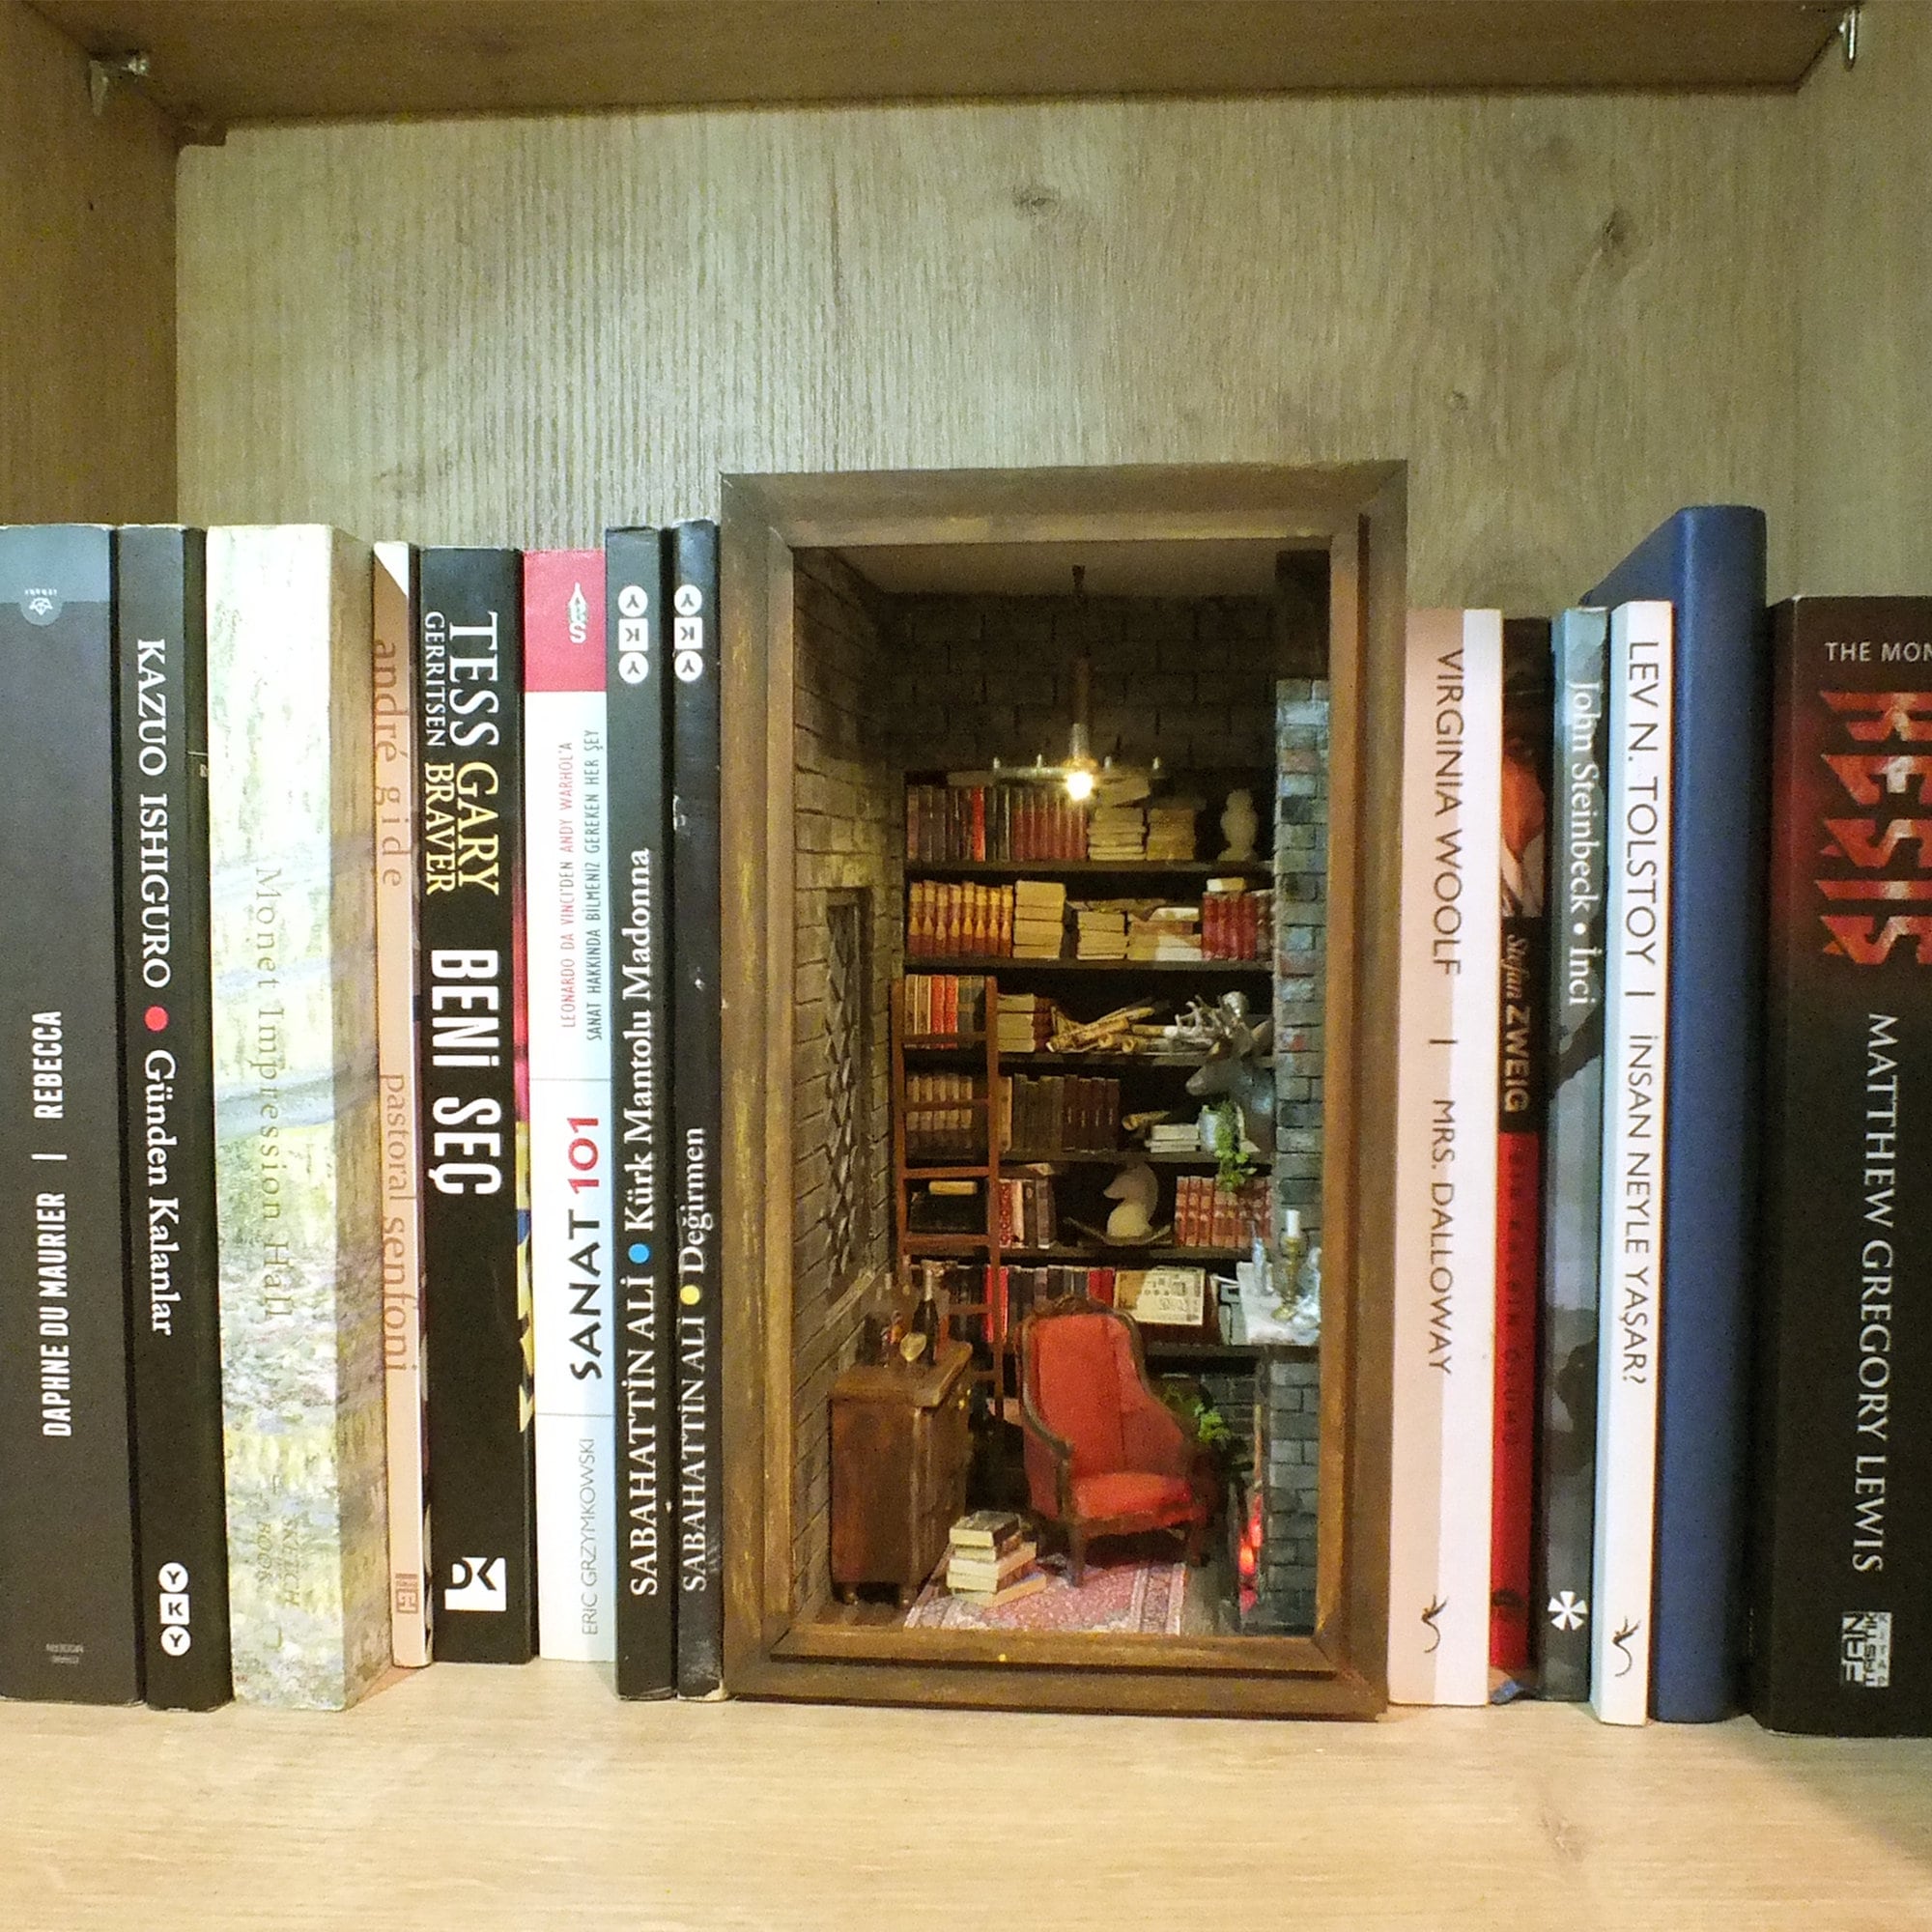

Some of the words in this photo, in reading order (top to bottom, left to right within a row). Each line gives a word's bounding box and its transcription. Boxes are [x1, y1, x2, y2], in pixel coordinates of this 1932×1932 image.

[373, 639, 409, 762] andré
[424, 611, 446, 748] GERRITSEN
[449, 611, 500, 748] TESS
[1627, 641, 1660, 708] LEV
[1824, 640, 1872, 663] THE
[137, 639, 168, 777] KAZUO
[582, 728, 605, 753] ŞEY
[1435, 648, 1464, 817] VIRGINIA
[1569, 681, 1603, 753] John
[1627, 722, 1660, 762] N.
[557, 741, 574, 814] WARHOL'A
[584, 758, 600, 786] HER
[584, 790, 601, 854] GEREKEN
[374, 785, 411, 888] gide
[424, 762, 456, 896] BRAVER
[456, 761, 500, 896] GARY
[558, 819, 574, 854] ANDY
[1570, 763, 1603, 914] Steinbeck
[1624, 777, 1660, 966] TOLSTOY
[139, 793, 172, 989] ISHIGURO
[256, 867, 283, 988] Monet
[558, 860, 574, 924] VINCI'DEN
[559, 929, 575, 952] DA
[621, 847, 652, 1001] Madonna
[1433, 828, 1463, 976] WOOLF
[559, 957, 577, 1029] LEONARDO
[584, 928, 602, 994] HAKKINDA
[1500, 933, 1530, 999] Stefan
[1569, 948, 1604, 1006] İnci
[32, 1011, 63, 1119] REBECCA
[585, 1002, 603, 1041] SANAT
[1504, 1005, 1530, 1114] ZWEIG
[144, 1049, 178, 1186] Günden
[249, 1008, 289, 1220] Impression
[623, 1009, 654, 1145] Mantolu
[1627, 1035, 1661, 1139] İNSAN
[1862, 1012, 1899, 1228] MATTHEW
[380, 1074, 416, 1201] pastoral
[428, 1096, 502, 1195] SEÇ
[567, 1117, 600, 1194] 101
[1430, 1098, 1456, 1169] MRS.
[39, 1192, 68, 1298] MAURIER
[624, 1152, 654, 1232] Kürk
[679, 1126, 714, 1274] Değirmen
[1625, 1151, 1651, 1255] NEYLE
[41, 1301, 69, 1337] DU
[147, 1198, 181, 1337] Kalanlar
[263, 1240, 294, 1319] Hall
[383, 1215, 418, 1374] senfoni
[568, 1208, 603, 1380] SANAT
[620, 1275, 655, 1339] ALİ
[1428, 1180, 1456, 1376] DALLOWAY
[677, 1316, 706, 1372] ALİ
[1618, 1264, 1651, 1385] YAŞAR?
[1857, 1238, 1894, 1442] GREGORY
[42, 1342, 71, 1437] DAPHNE
[579, 1437, 598, 1587] GRZYMKOWSKI
[621, 1349, 658, 1596] SABAHATTİN
[678, 1375, 707, 1592] SABAHATTİN
[1852, 1454, 1887, 1574] LEWIS
[581, 1593, 598, 1635] ERIC
